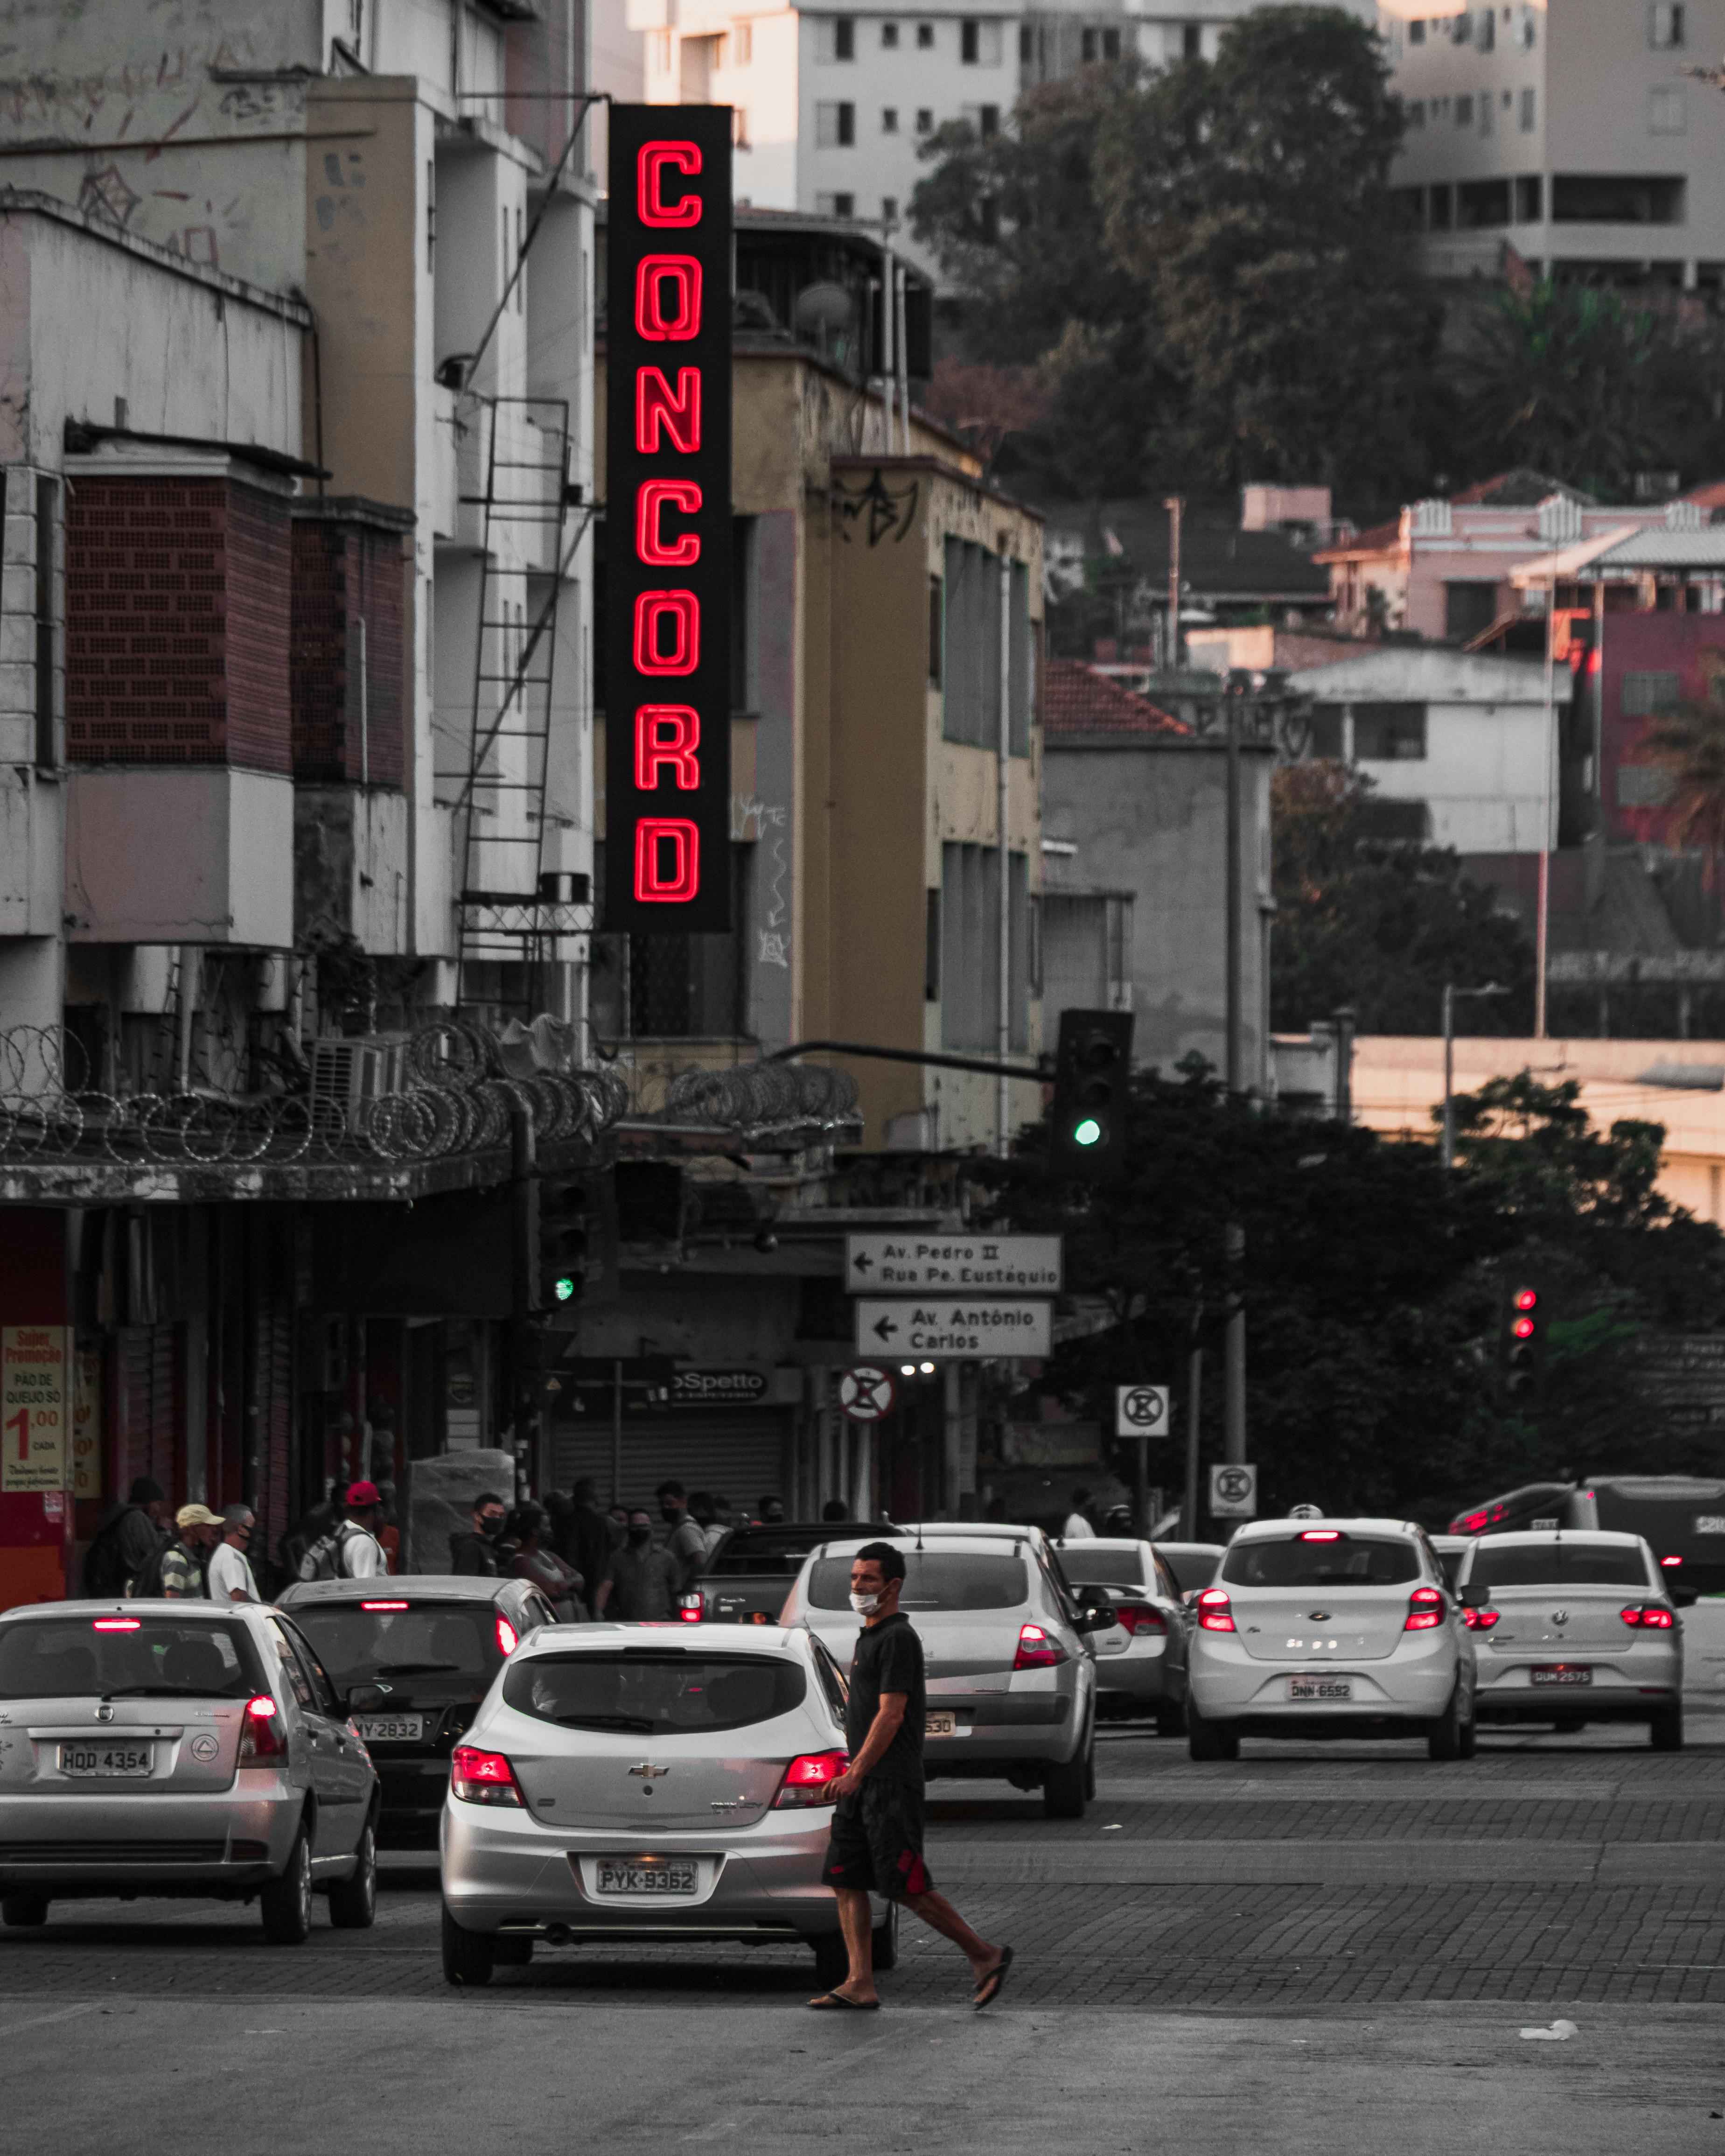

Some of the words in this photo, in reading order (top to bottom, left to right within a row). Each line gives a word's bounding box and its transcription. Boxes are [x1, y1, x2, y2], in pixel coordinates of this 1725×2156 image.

[634, 141, 702, 902] CONCORD
[884, 1244, 910, 1259] Av.
[916, 1244, 974, 1260] Pedro
[983, 1245, 999, 1260] II
[882, 1266, 917, 1282] Rua
[960, 1263, 1057, 1286] Eustáquio
[910, 1332, 979, 1349] Carlos
[39, 1373, 53, 1386] DE
[33, 1441, 56, 1450] CADA
